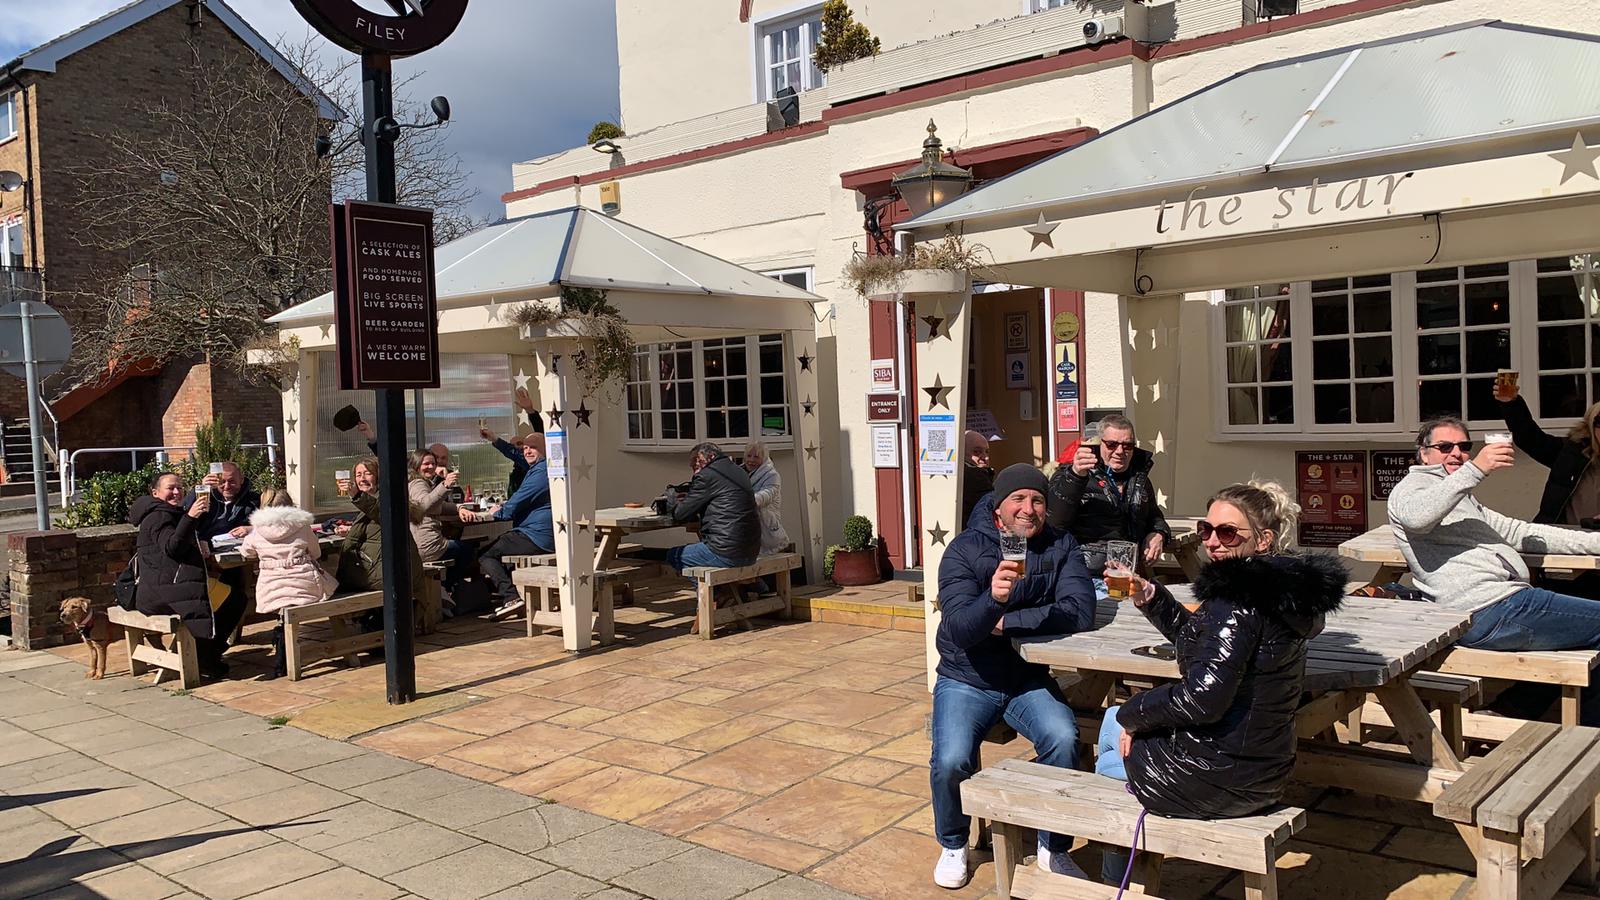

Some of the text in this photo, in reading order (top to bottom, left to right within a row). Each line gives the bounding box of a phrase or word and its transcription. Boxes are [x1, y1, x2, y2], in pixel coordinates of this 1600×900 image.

[355, 17, 406, 41] FILEY
[1154, 172, 1414, 235] the star
[370, 240, 409, 249] SELECTION
[362, 247, 421, 259] CASK ALES
[381, 268, 422, 277] HOMEMADE
[390, 275, 423, 284] SERVED
[363, 291, 424, 302] BIG SCREEN
[389, 302, 424, 310] SPORTS
[367, 352, 426, 361] WELCOME
[874, 369, 892, 378] SIBA
[1383, 457, 1405, 465] THE
